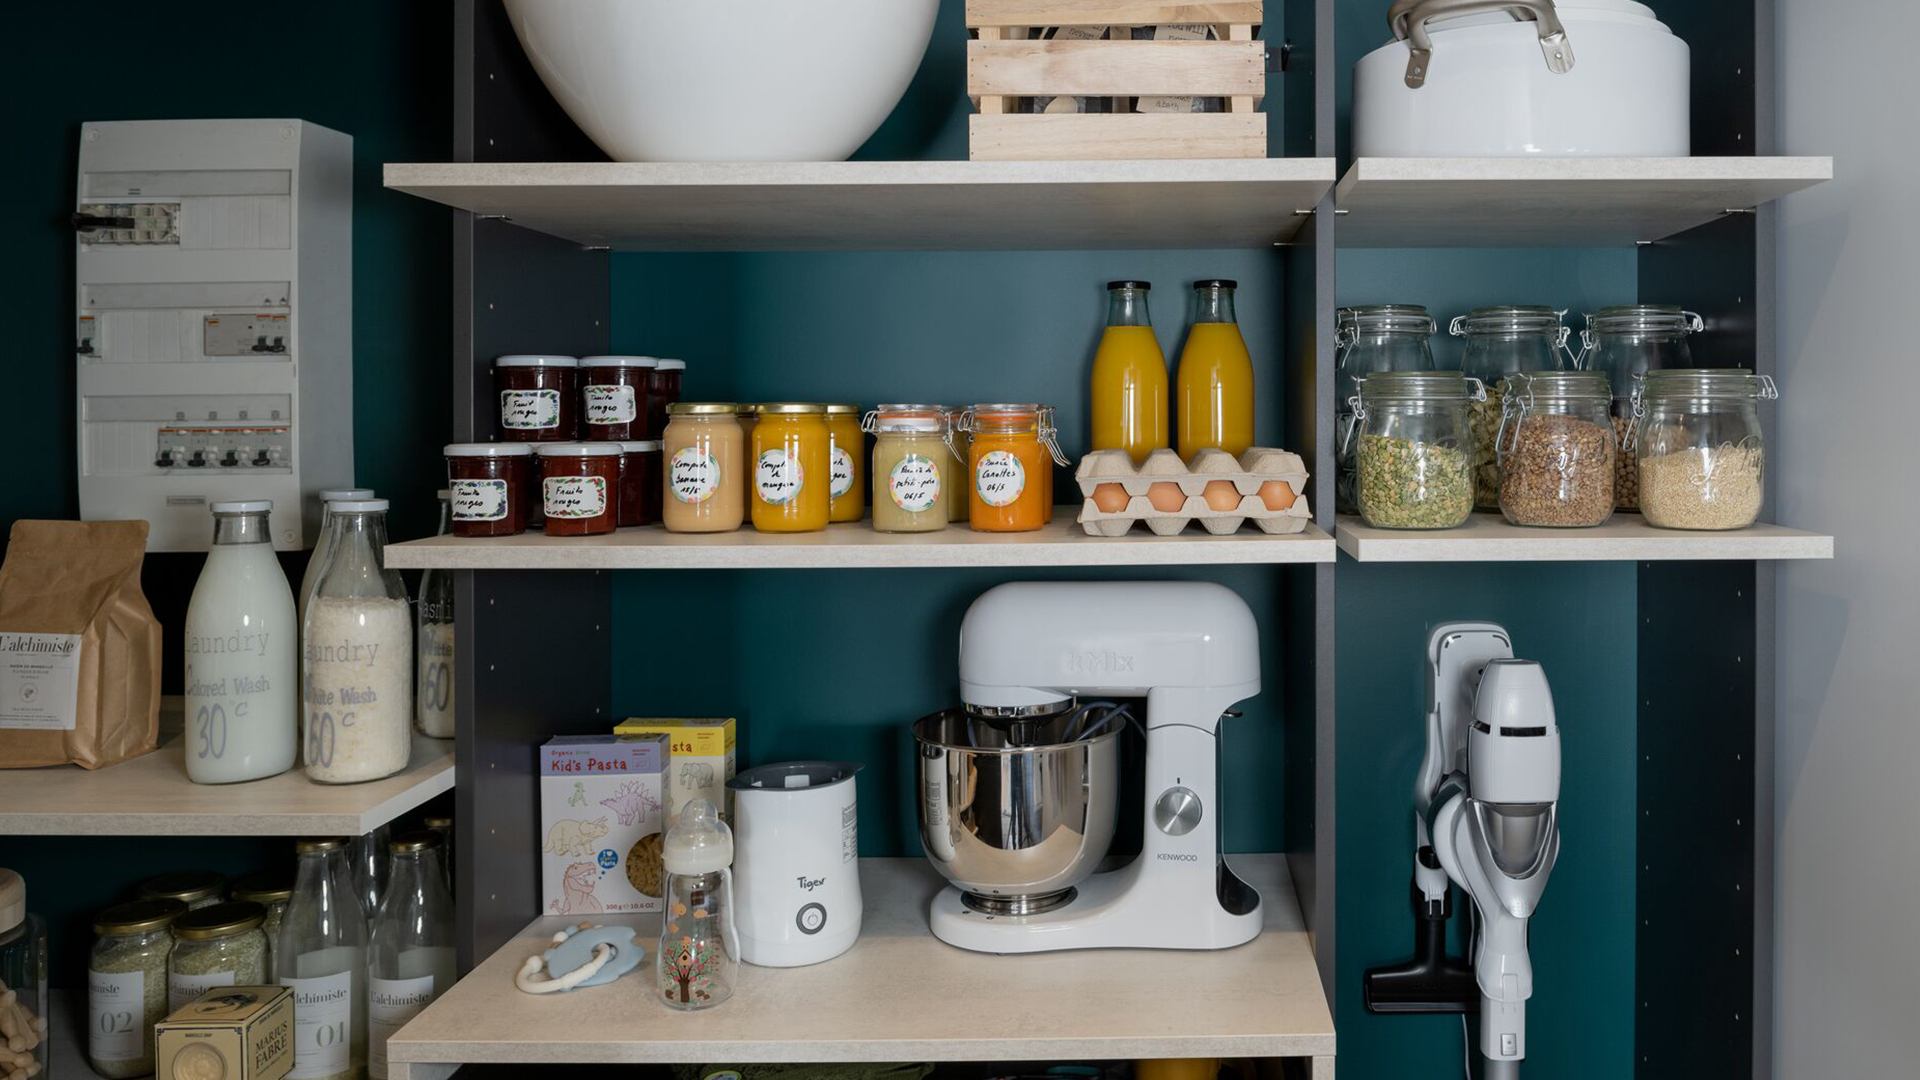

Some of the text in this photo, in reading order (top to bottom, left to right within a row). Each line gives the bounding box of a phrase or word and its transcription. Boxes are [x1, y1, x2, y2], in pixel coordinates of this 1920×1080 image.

[552, 757, 627, 772] Kid's Pasta
[1157, 853, 1198, 862] KENWOOD
[101, 1010, 134, 1034] 02
